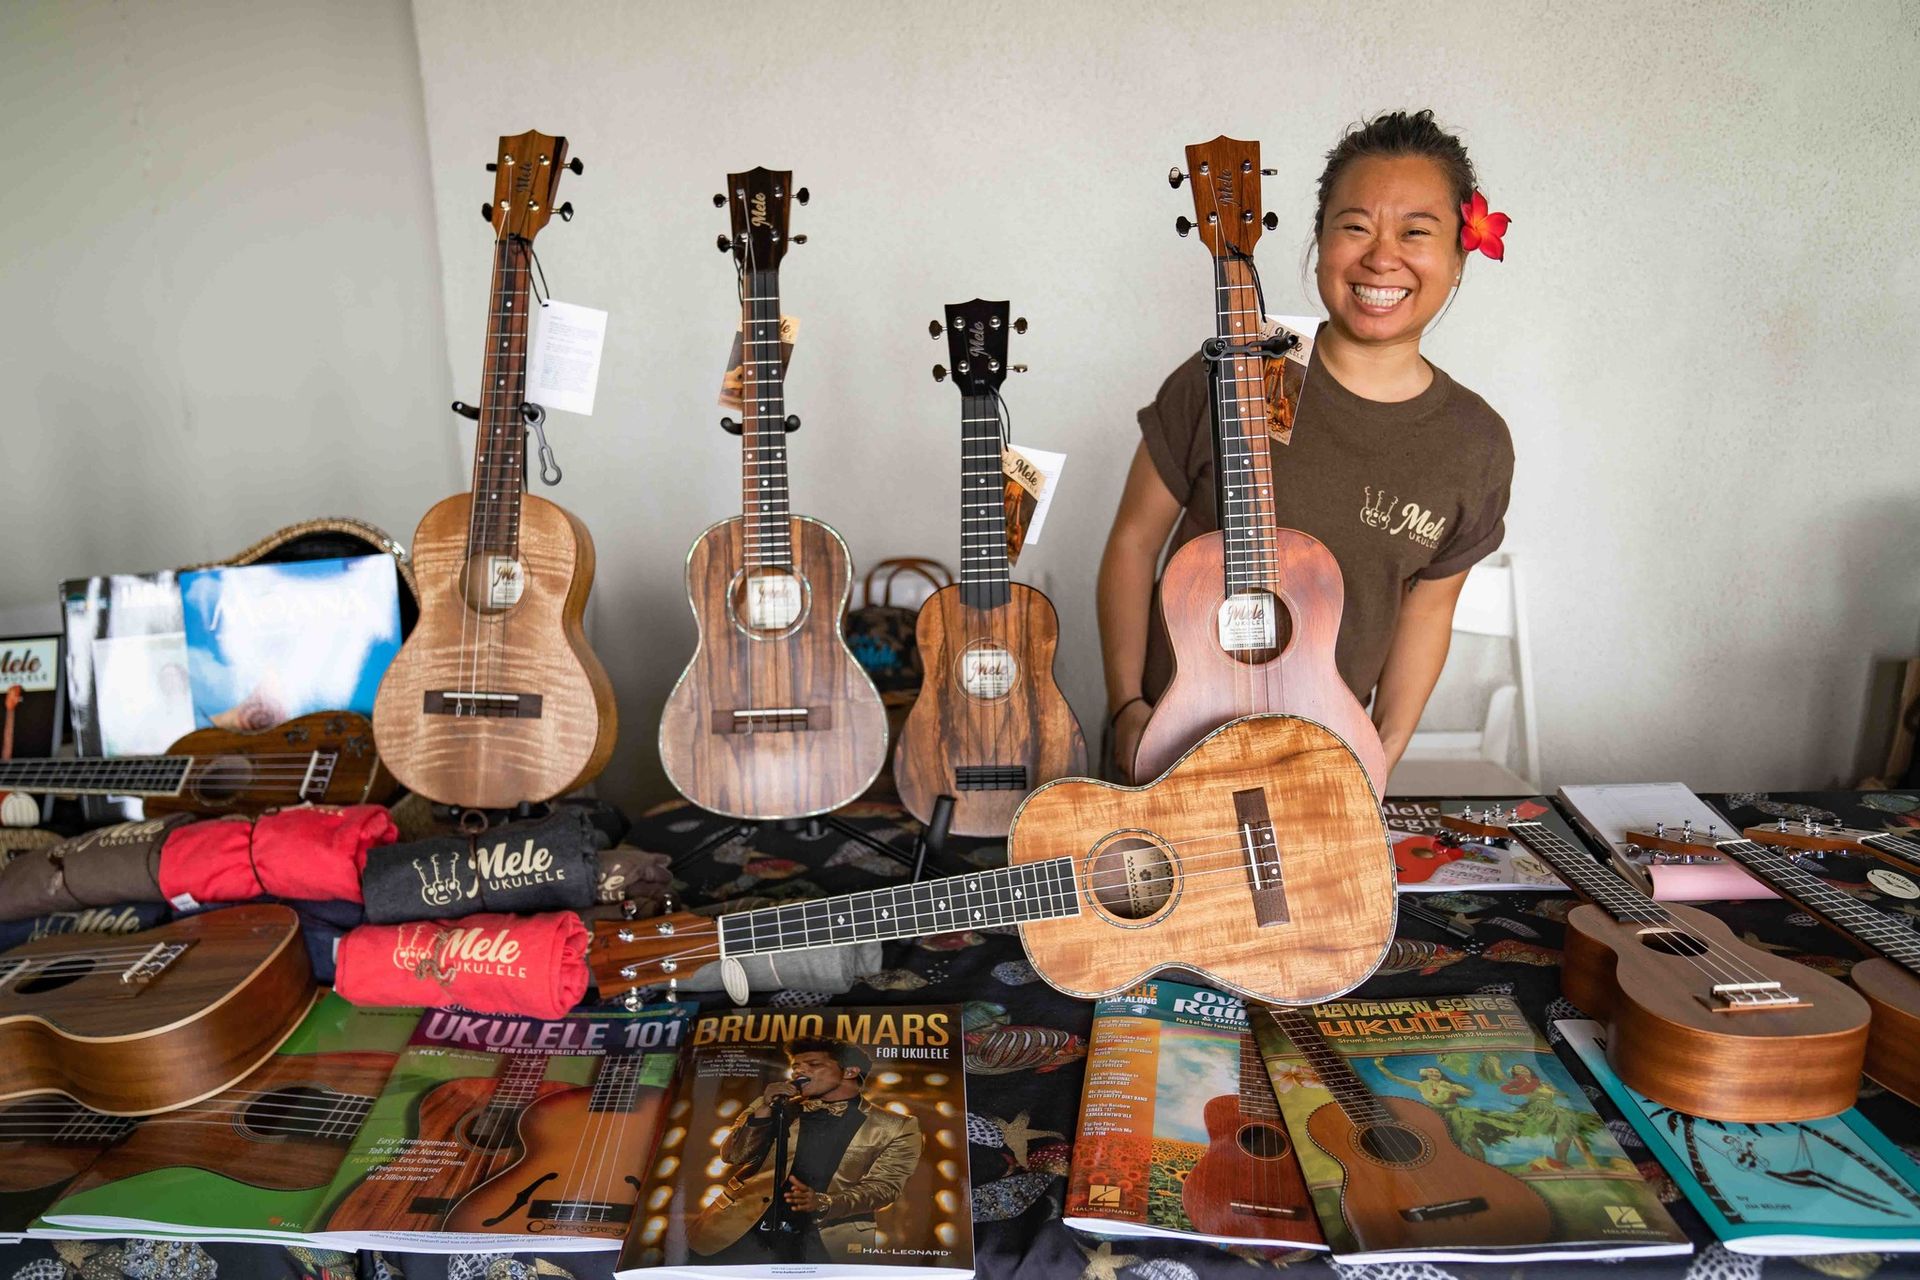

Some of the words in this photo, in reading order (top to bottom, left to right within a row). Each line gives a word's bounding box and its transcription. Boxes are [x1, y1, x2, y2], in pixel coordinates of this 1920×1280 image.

[751, 192, 773, 228] Mele
[969, 321, 992, 358] Mele
[1010, 459, 1037, 486] Mele
[0, 649, 42, 673] ele
[466, 839, 553, 898] Mele
[489, 869, 566, 891] UKULELE
[440, 927, 522, 969] Mele
[1312, 1001, 1433, 1018] HAWAIIAN
[1436, 998, 1515, 1012] SONGS
[425, 1012, 610, 1049] UKULELE
[623, 1020, 682, 1048] 101
[692, 1014, 824, 1046] BRUNO
[836, 1013, 950, 1046] MARS
[1318, 1014, 1529, 1037] UKULELE
[418, 1049, 446, 1057] KEV
[876, 1047, 898, 1058] FOR
[902, 1048, 950, 1059] UKULELE
[392, 1147, 419, 1155] Music
[419, 1148, 459, 1157] Notation
[398, 1137, 459, 1148] Arrangements
[374, 1165, 422, 1173] Progressions
[439, 1159, 466, 1167] Strums
